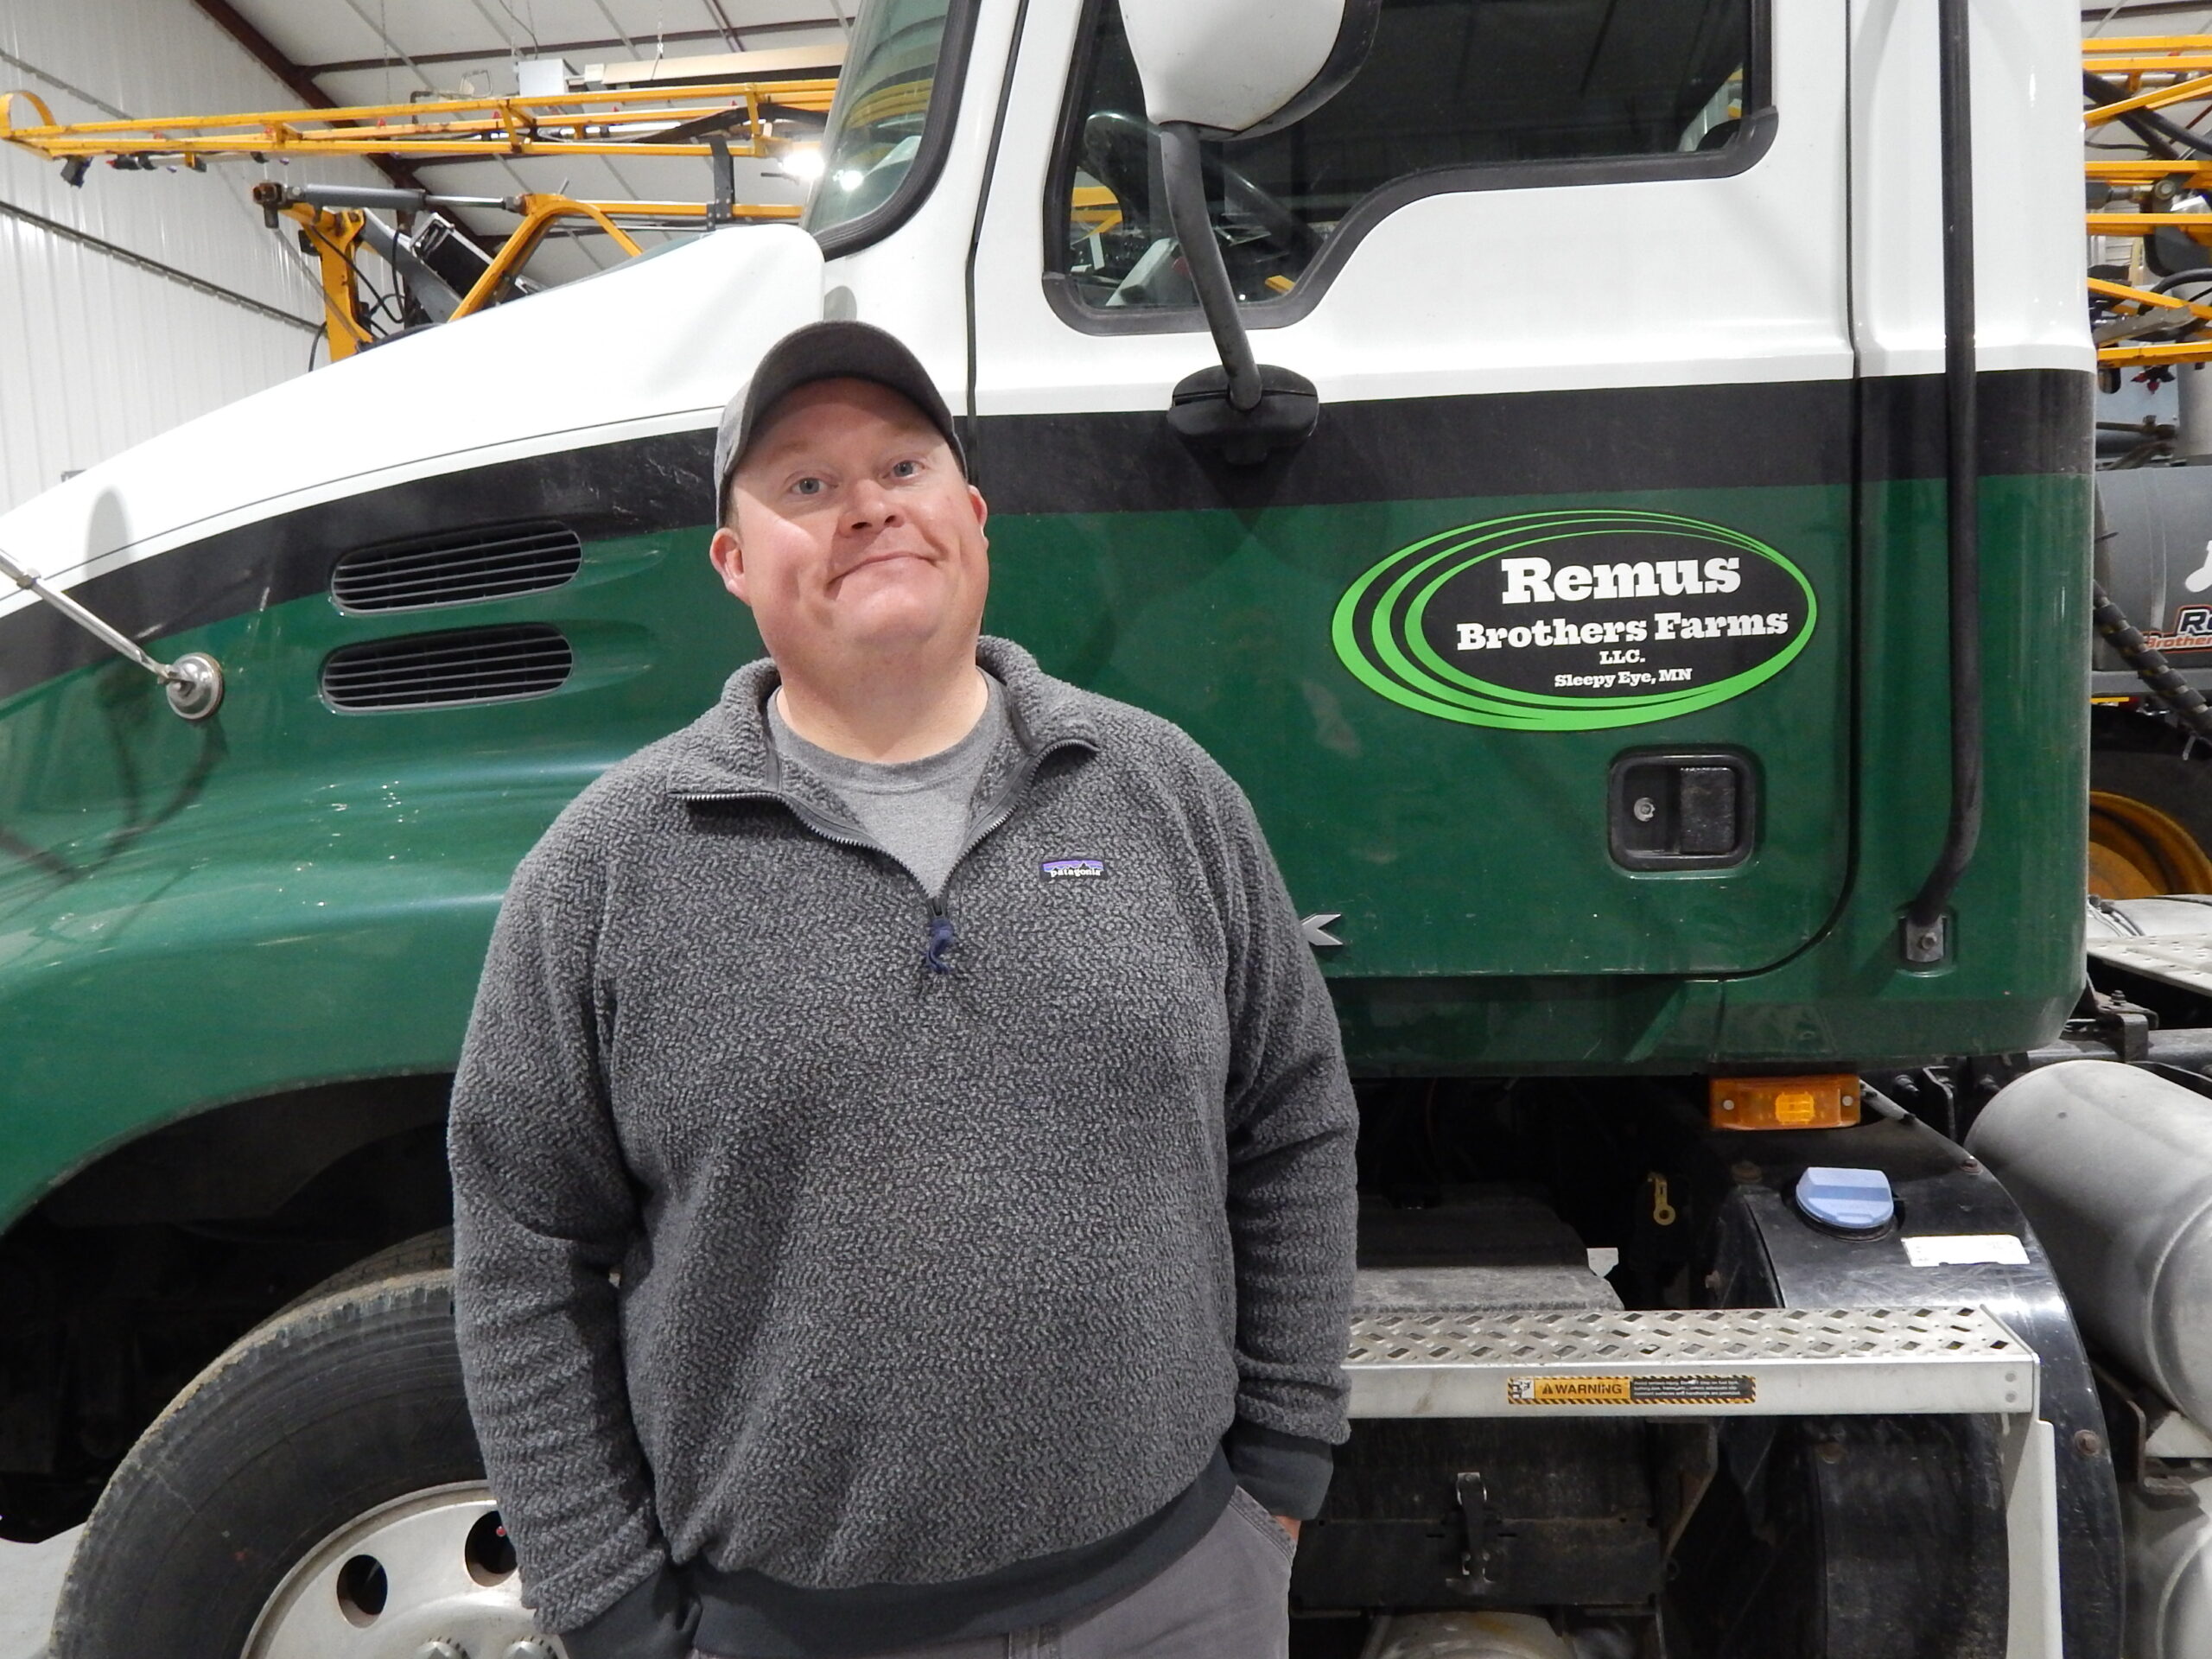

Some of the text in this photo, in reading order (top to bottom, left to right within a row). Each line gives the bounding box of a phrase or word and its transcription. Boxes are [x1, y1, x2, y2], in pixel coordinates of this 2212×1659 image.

[1501, 556, 1742, 605] Remus
[1456, 611, 1789, 651] Brothers Farms
[1599, 649, 1646, 664] LLC.
[1554, 668, 1693, 689] Sleepy Eye, MN
[1050, 868, 1102, 878] patagonia
[1554, 1383, 1623, 1395] WARNING
